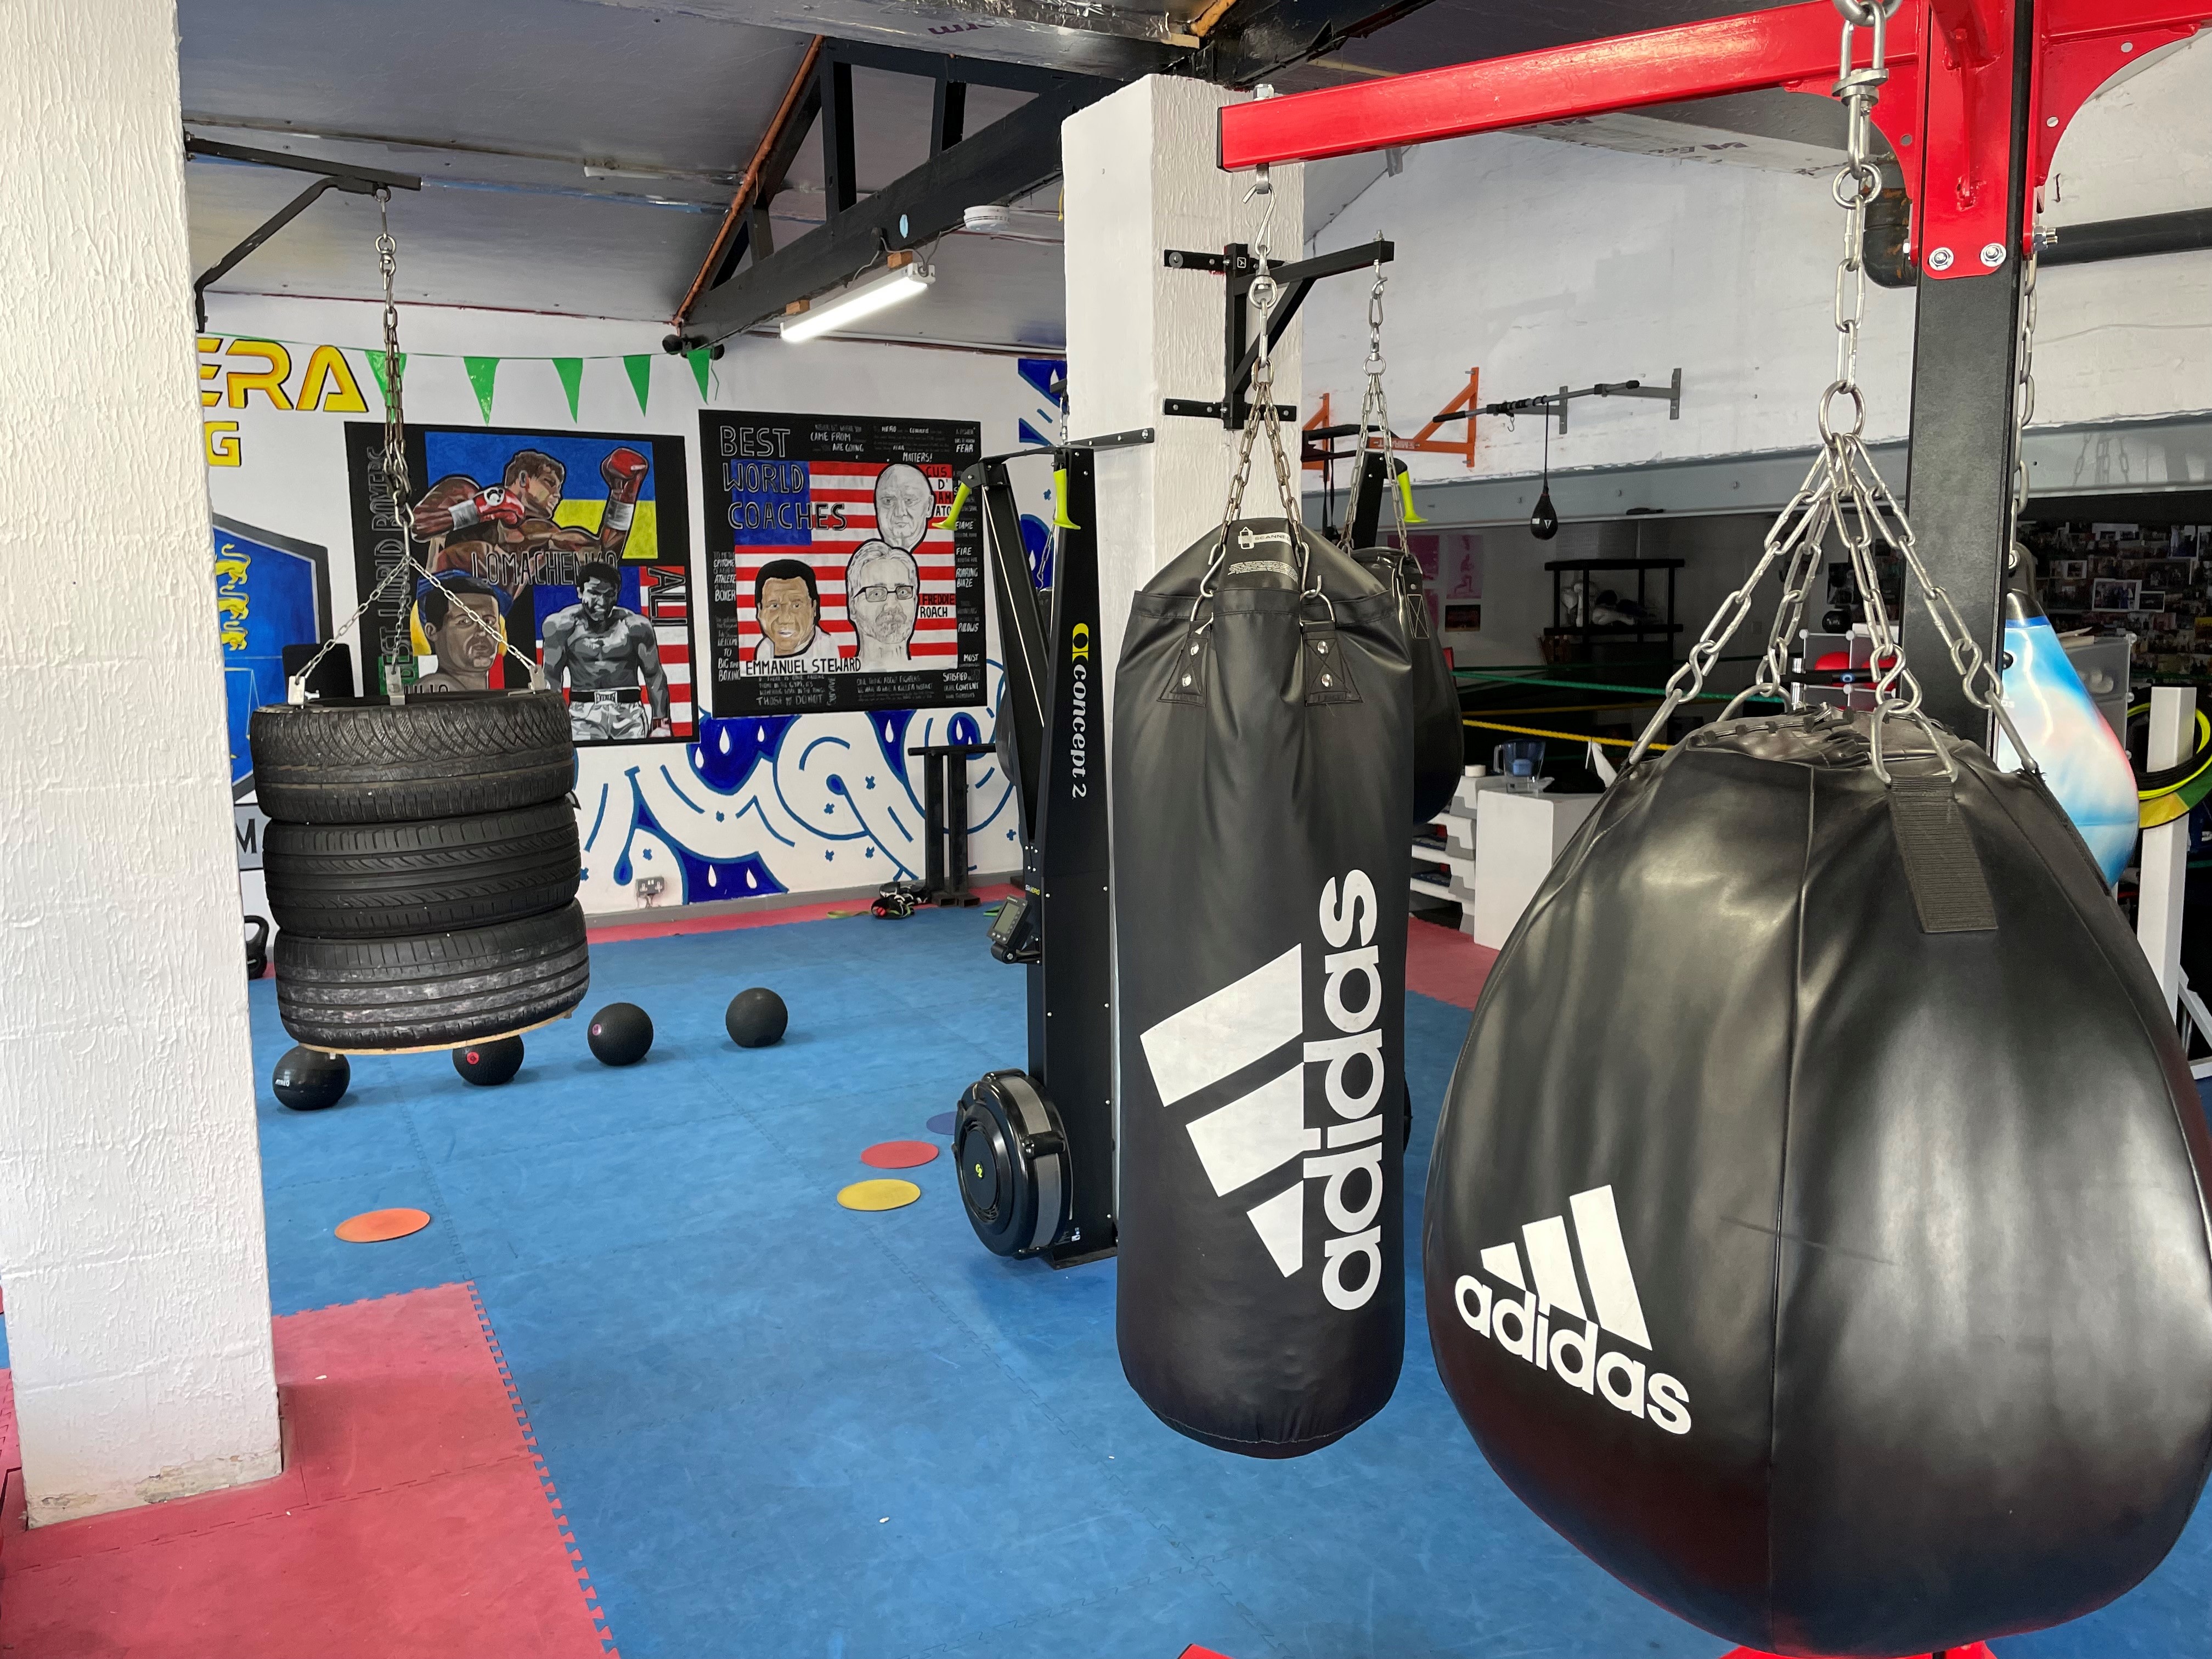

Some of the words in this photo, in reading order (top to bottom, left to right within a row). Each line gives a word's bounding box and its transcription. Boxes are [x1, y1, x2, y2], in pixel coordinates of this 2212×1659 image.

[720, 425, 791, 458] BEST
[810, 431, 828, 442] CAME
[831, 432, 851, 442] FROM
[204, 421, 242, 467] G
[845, 443, 864, 452] GOING
[956, 444, 974, 453] FEAR
[902, 452, 933, 462] MATTERS!
[926, 466, 947, 477] CUS
[723, 462, 804, 493] WORLD
[938, 479, 948, 490] D'
[727, 501, 849, 531] COACHES
[956, 547, 972, 556] FIRE
[955, 568, 978, 578] ROARING
[714, 574, 736, 584] ATHLETE
[647, 566, 688, 626] ALI
[715, 589, 736, 602] BOXER
[922, 593, 956, 606] FREDDIE
[920, 606, 948, 618] ROACH
[958, 622, 979, 633] PILLOWS
[724, 648, 732, 657] TO
[963, 653, 979, 662] MOST
[718, 657, 729, 669] BIG
[746, 659, 808, 675] EMMANUEL
[812, 658, 861, 673] STEWARD
[718, 669, 741, 682] BOXING
[943, 672, 968, 682] SATISFIED
[956, 681, 979, 691] CONTENT
[756, 695, 782, 706] THOSE
[1070, 664, 1087, 778] concept
[1304, 868, 1385, 1311] adidas
[1454, 1274, 1691, 1435] adidas
